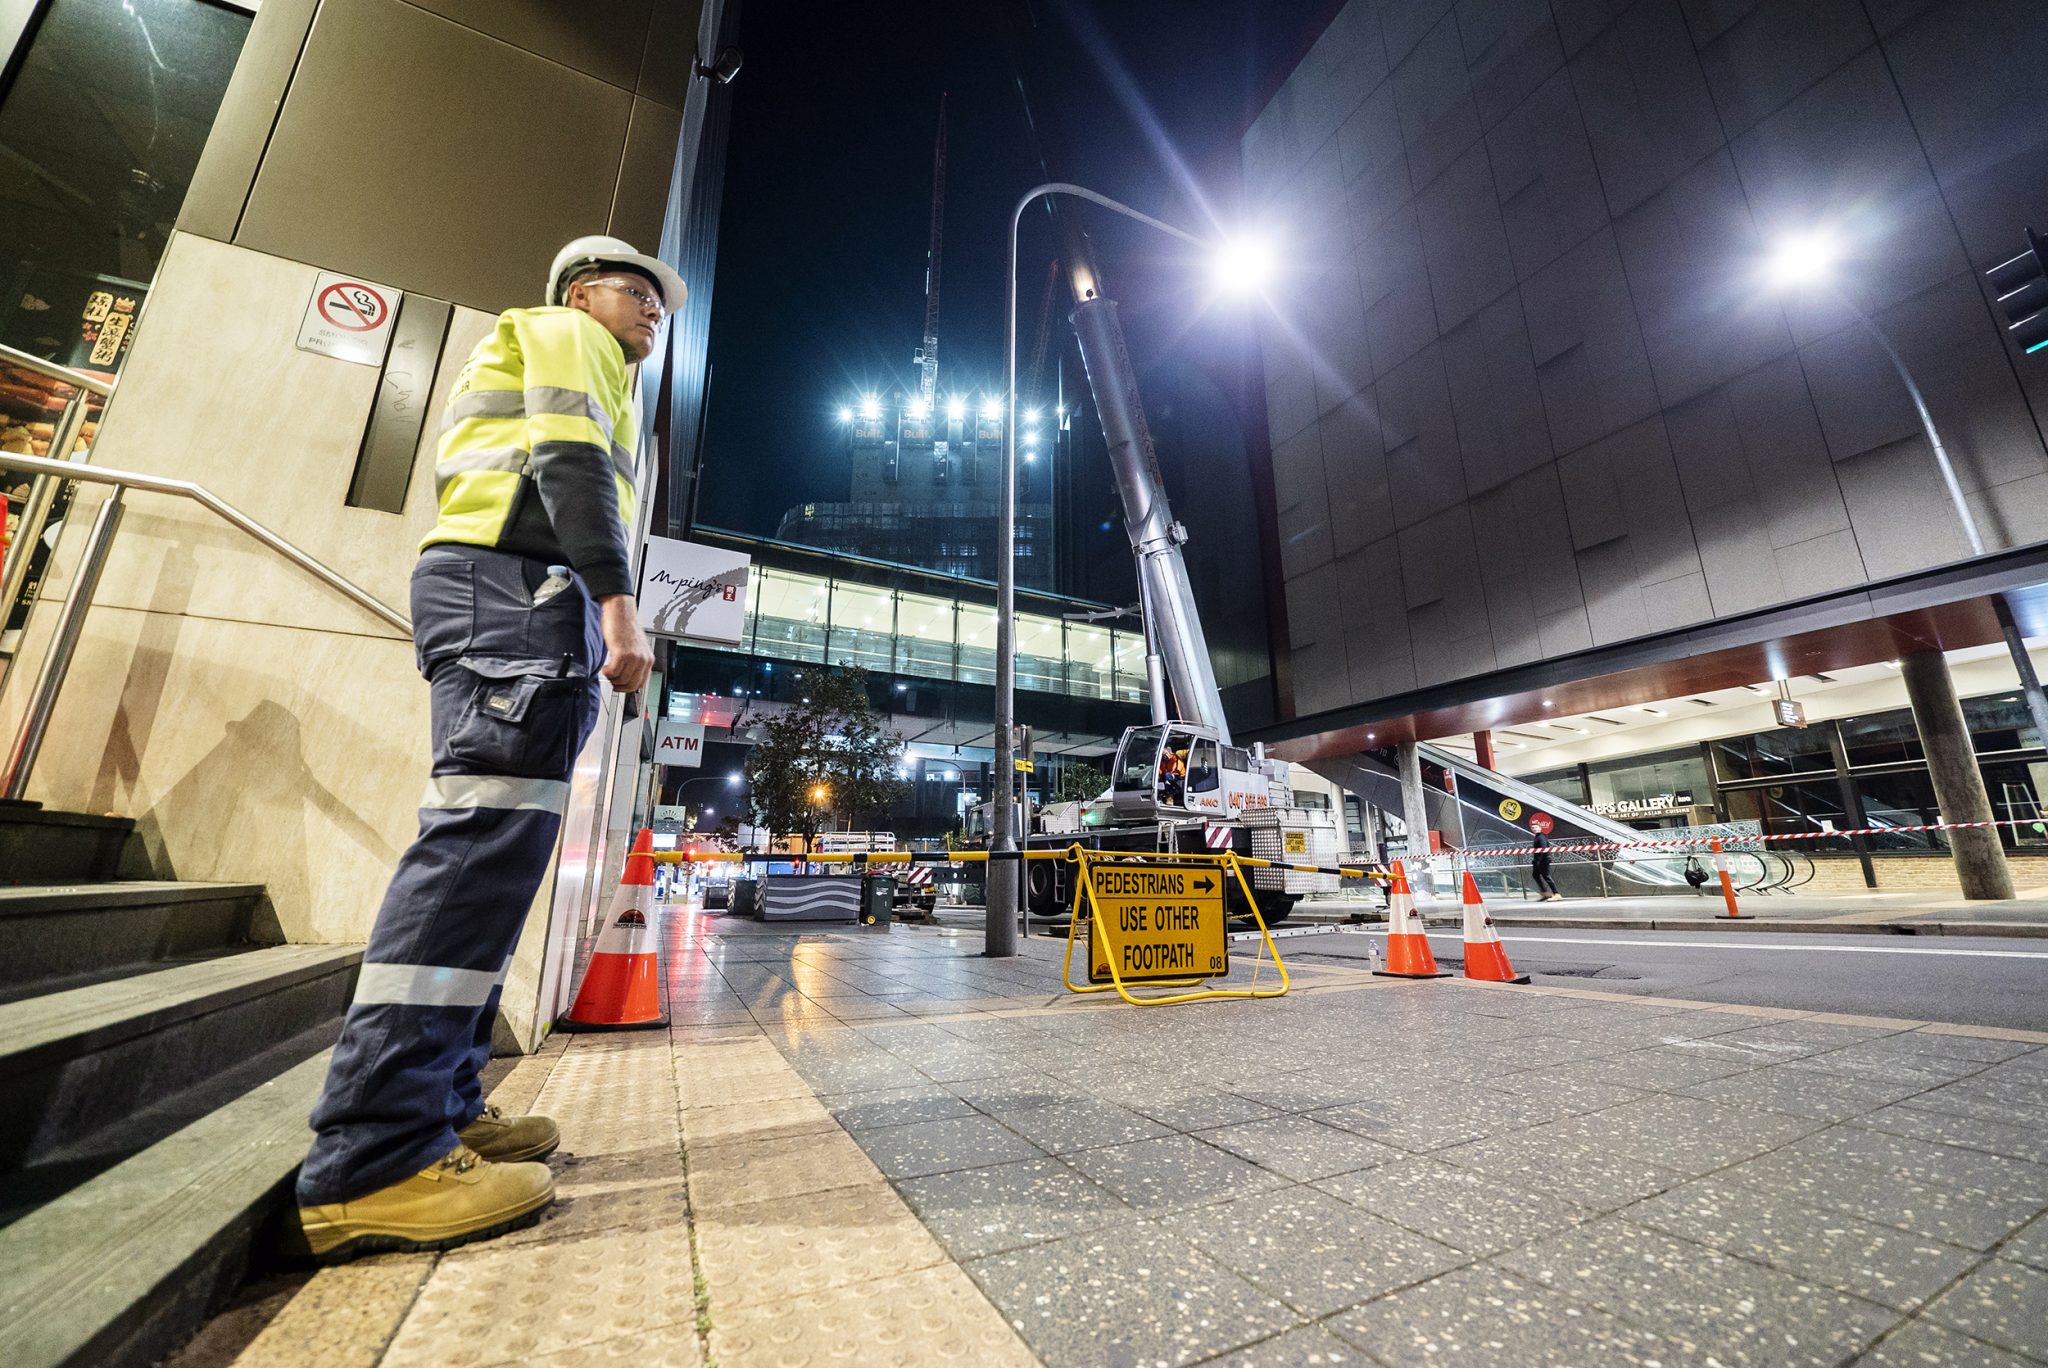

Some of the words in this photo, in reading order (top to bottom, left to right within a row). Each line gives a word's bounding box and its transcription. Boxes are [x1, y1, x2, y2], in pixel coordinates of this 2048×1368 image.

[661, 735, 699, 751] ATM
[1618, 797, 1674, 812] GALLERY
[1096, 872, 1185, 895] PEDESTRIANS
[1120, 906, 1147, 932] USE
[1155, 905, 1199, 931] OTHER
[1124, 943, 1194, 971] FOOTPATH
[1210, 956, 1222, 969] 08
